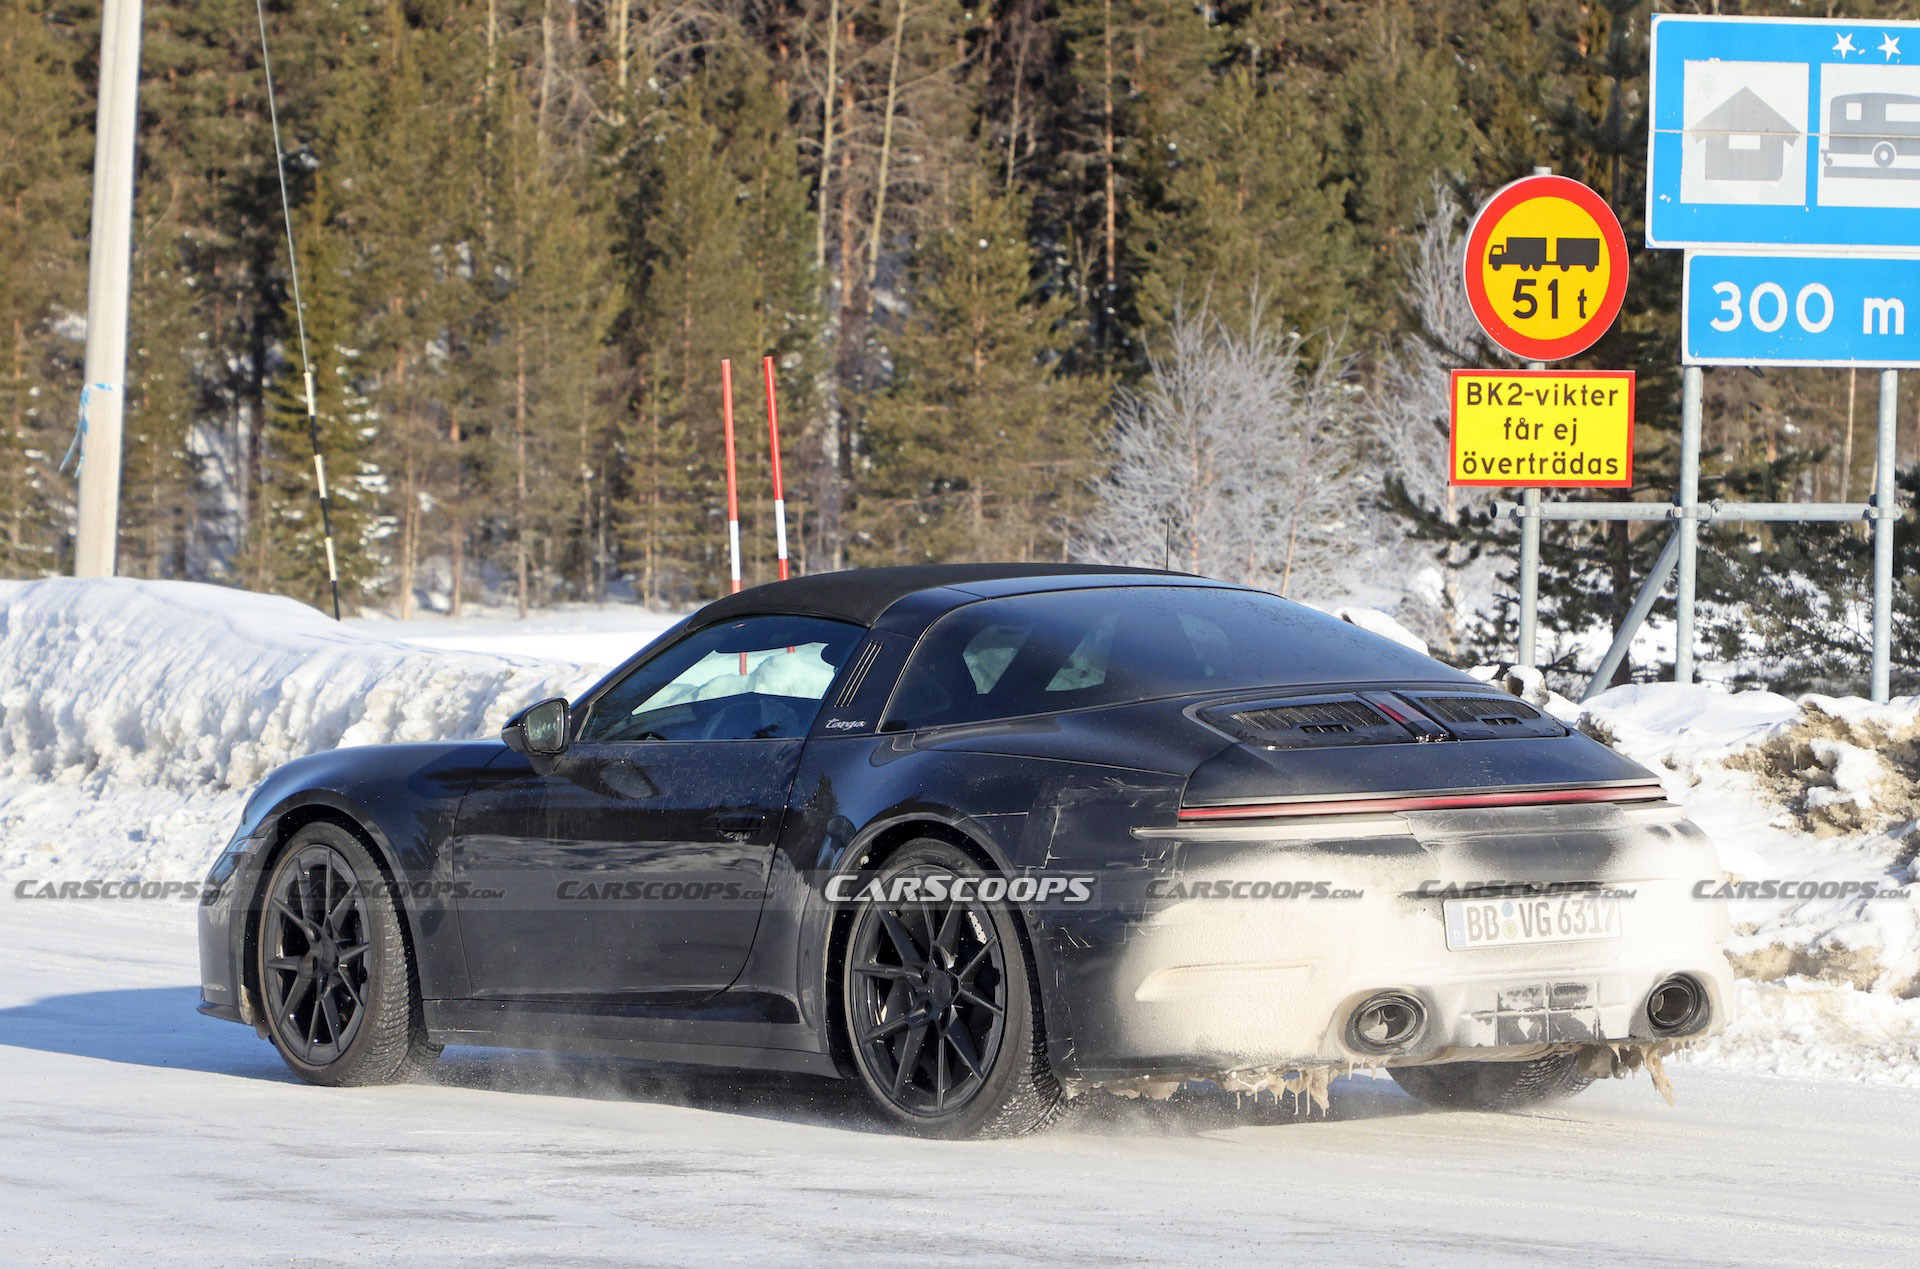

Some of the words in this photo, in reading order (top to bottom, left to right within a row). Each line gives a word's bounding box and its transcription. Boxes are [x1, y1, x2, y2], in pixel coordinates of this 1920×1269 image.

[1512, 278, 1559, 319] 51
[1577, 288, 1587, 319] t
[1710, 281, 1834, 334] 300
[1863, 296, 1905, 335] m
[1467, 382, 1619, 407] BK2-vikter
[1504, 417, 1544, 441] får
[1553, 417, 1577, 446] ej
[1462, 451, 1619, 475] överträdas
[825, 718, 866, 731] Targa
[1466, 906, 1500, 942] BB
[1519, 901, 1550, 938] VG
[1557, 899, 1616, 935] 6317
